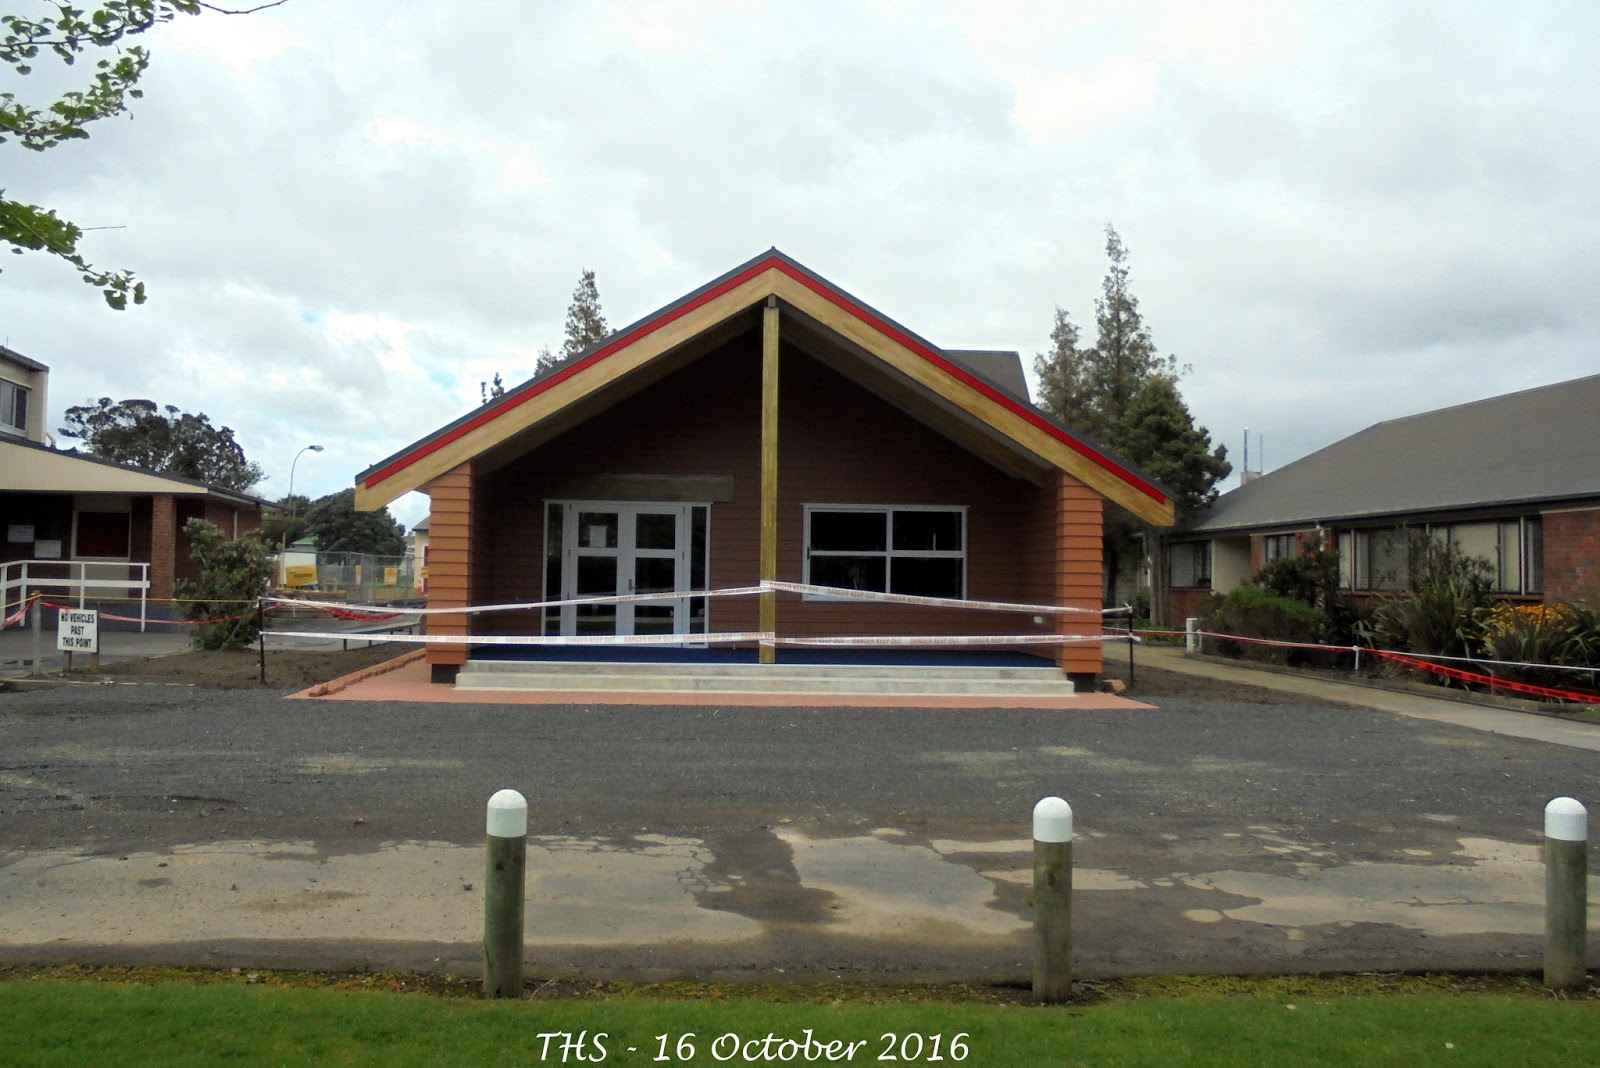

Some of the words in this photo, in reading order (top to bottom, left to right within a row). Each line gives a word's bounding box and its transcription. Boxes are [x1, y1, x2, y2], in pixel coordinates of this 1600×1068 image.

[770, 582, 793, 590] DANGER
[793, 584, 806, 592] KEEP
[827, 588, 849, 596] DANGER
[61, 613, 68, 622] NO
[70, 613, 94, 623] VEHICLES
[71, 625, 84, 635] PAST
[62, 637, 74, 647] THIS
[76, 638, 92, 648] POINT
